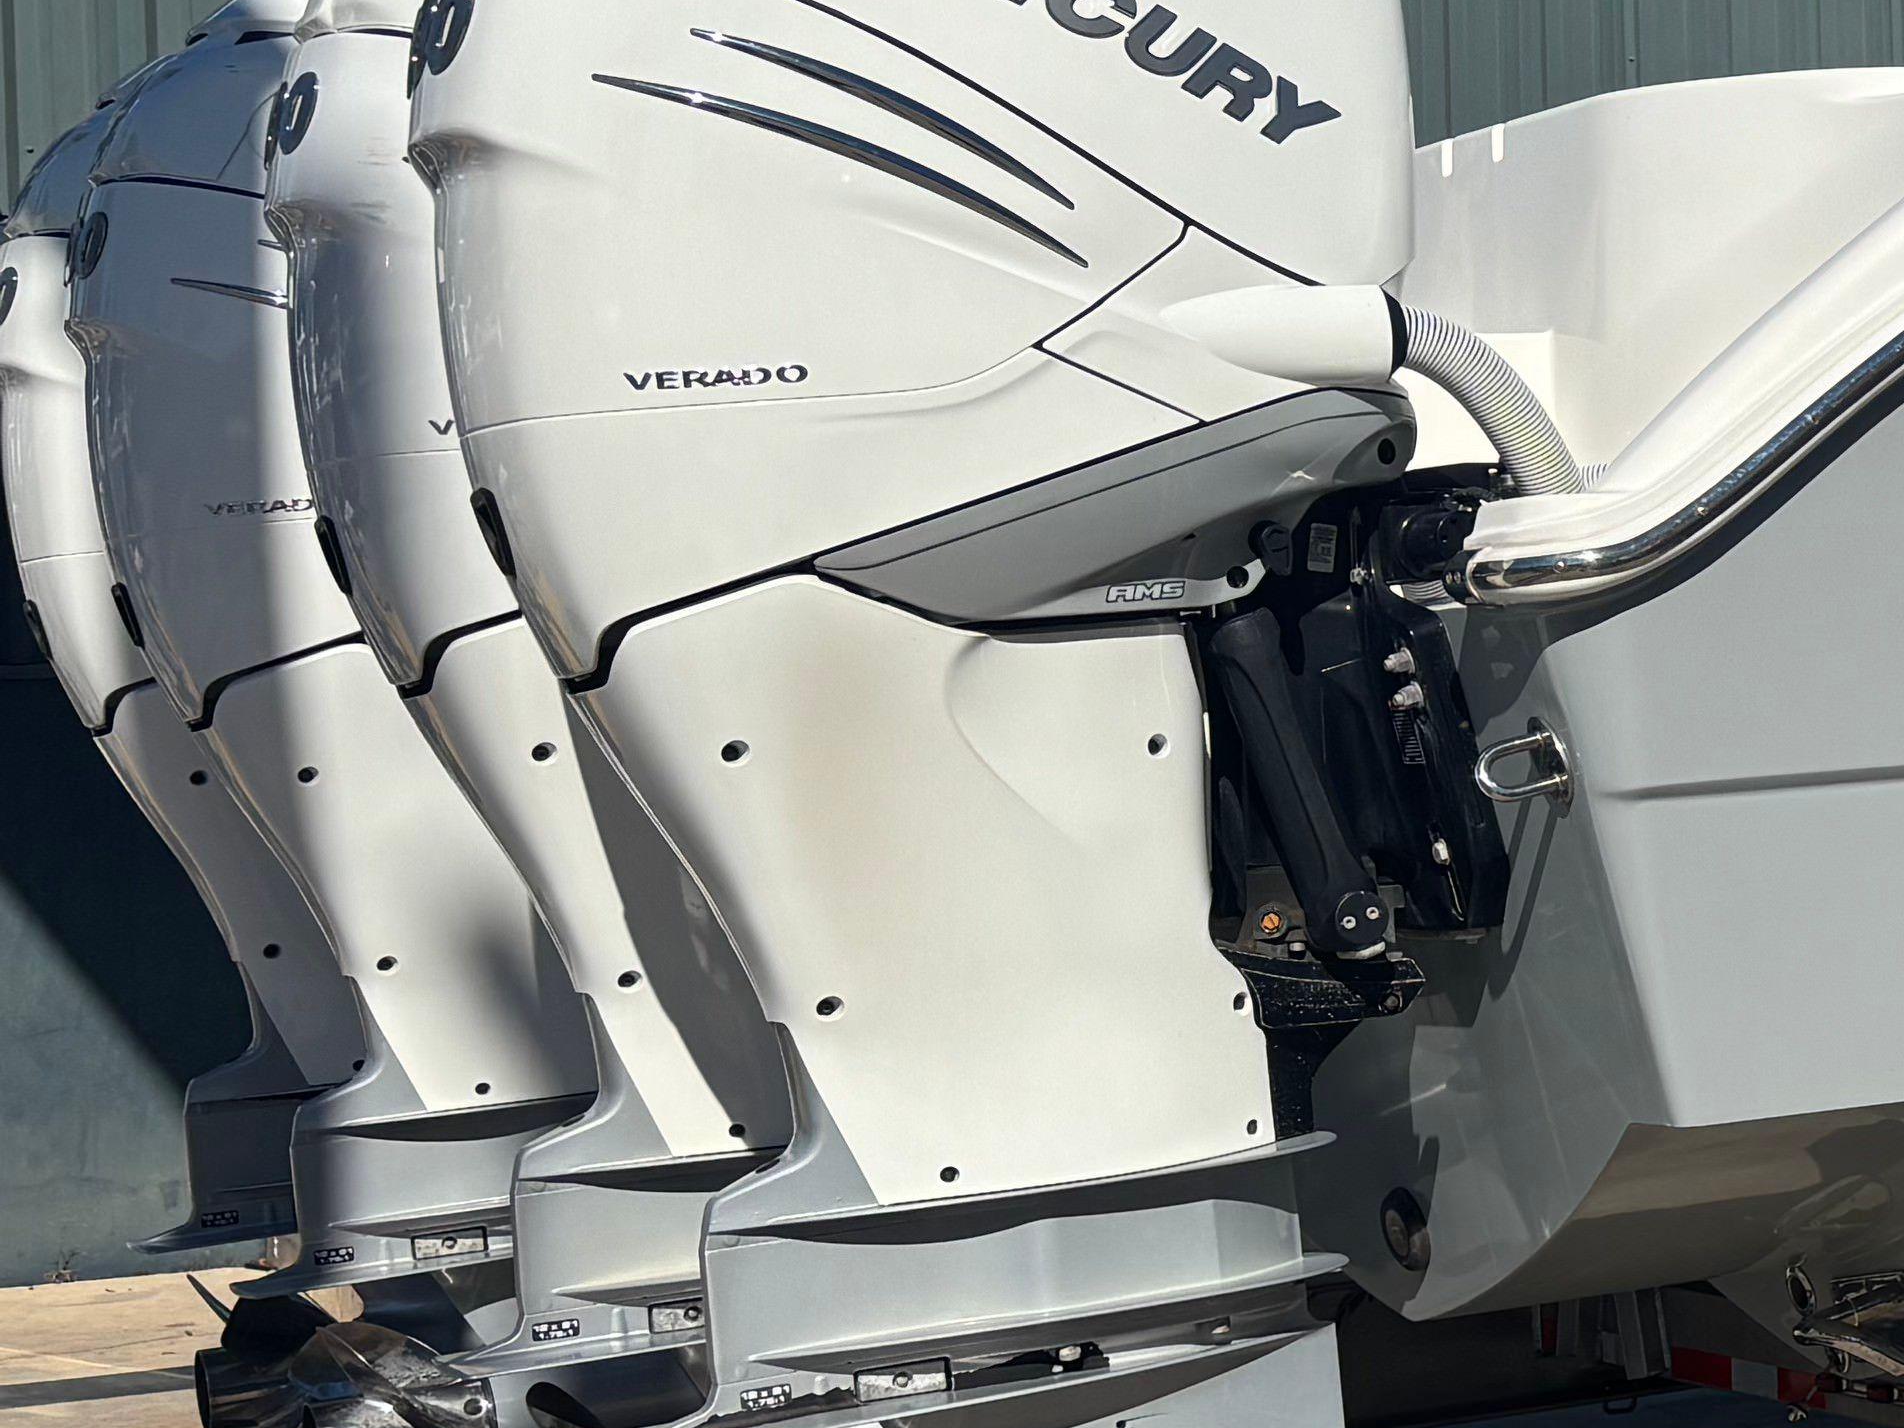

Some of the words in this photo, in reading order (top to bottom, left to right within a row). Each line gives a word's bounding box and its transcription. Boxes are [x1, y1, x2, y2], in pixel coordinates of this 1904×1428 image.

[623, 364, 808, 390] VERADO
[203, 498, 313, 515] VERAD
[1105, 580, 1186, 603] AMS
